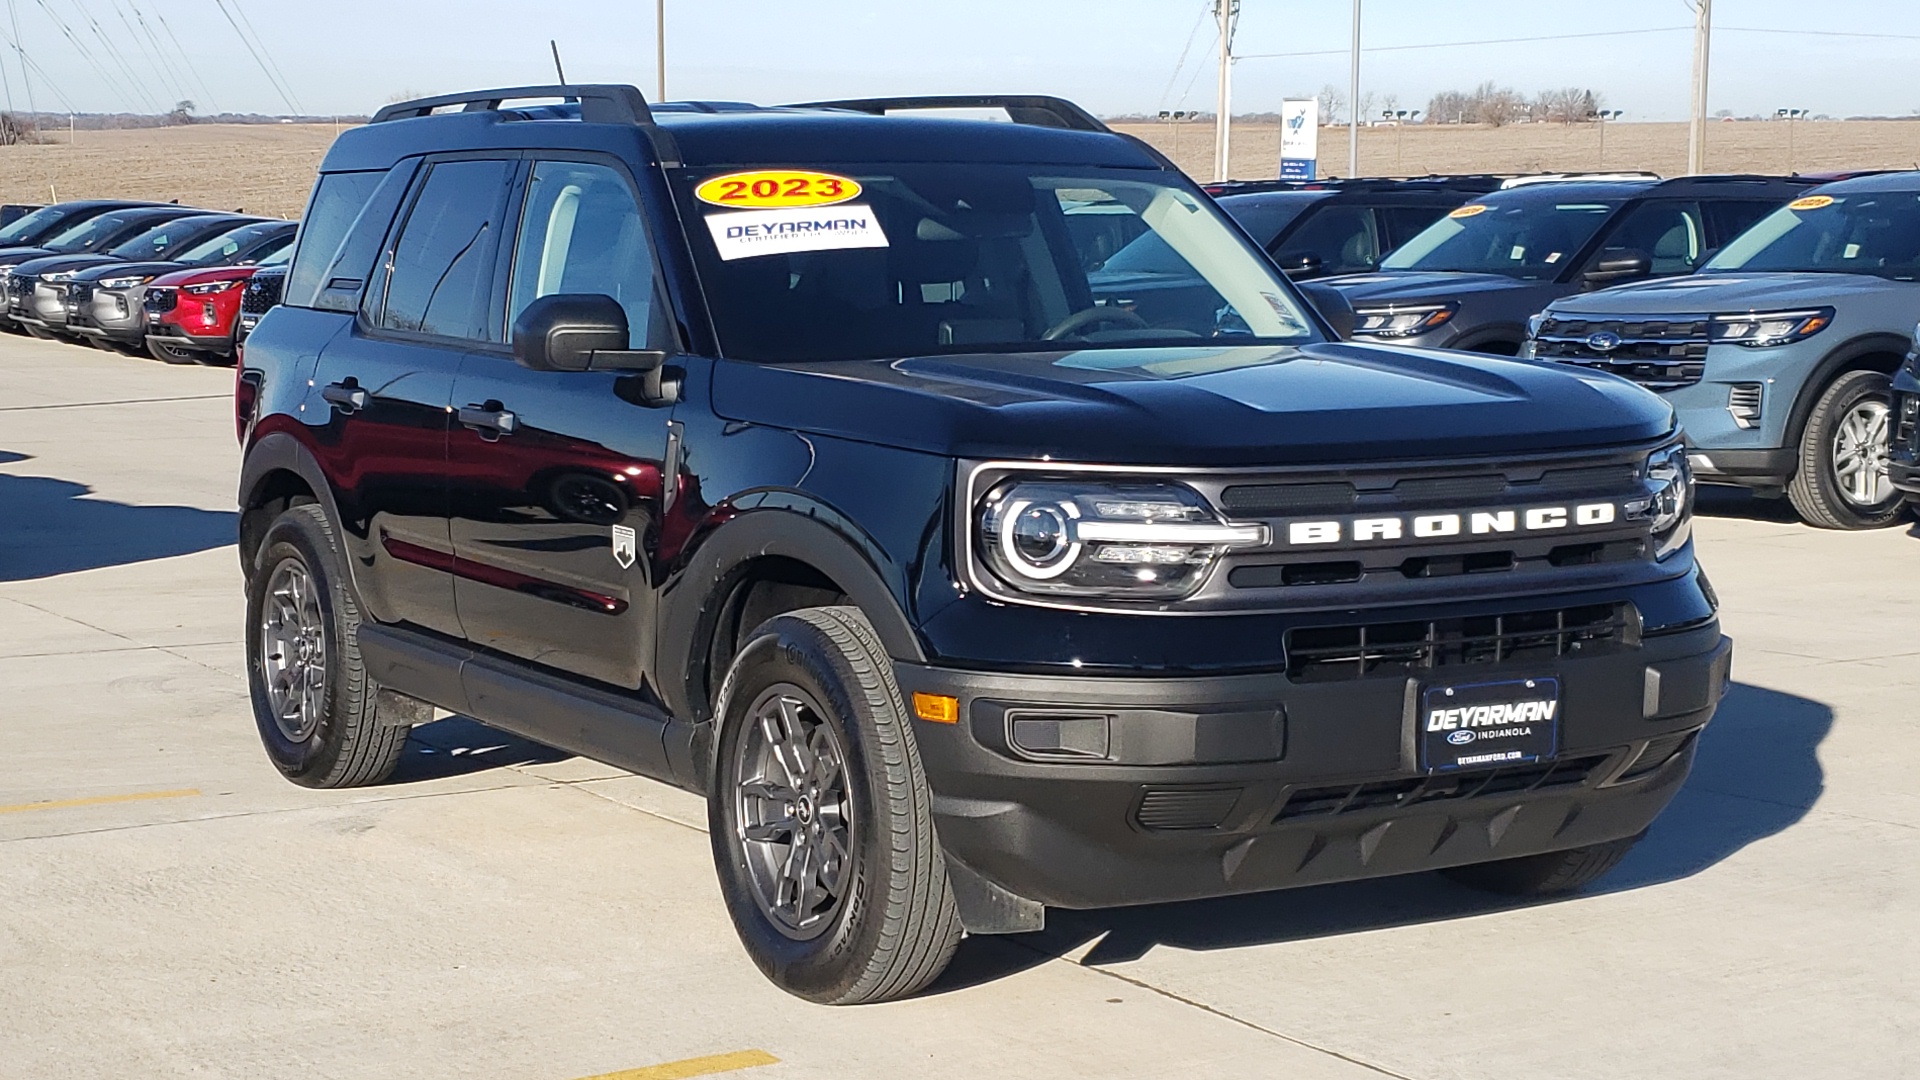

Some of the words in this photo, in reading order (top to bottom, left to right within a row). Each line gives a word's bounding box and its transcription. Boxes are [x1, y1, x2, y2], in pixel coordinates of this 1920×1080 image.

[719, 178, 843, 200] 2023
[727, 219, 866, 239] DEYARMAN
[1289, 503, 1614, 544] BRONCO
[1427, 701, 1556, 732] DEYARMAN
[1452, 733, 1470, 742] Ford
[1478, 727, 1531, 739] INDIANOLA
